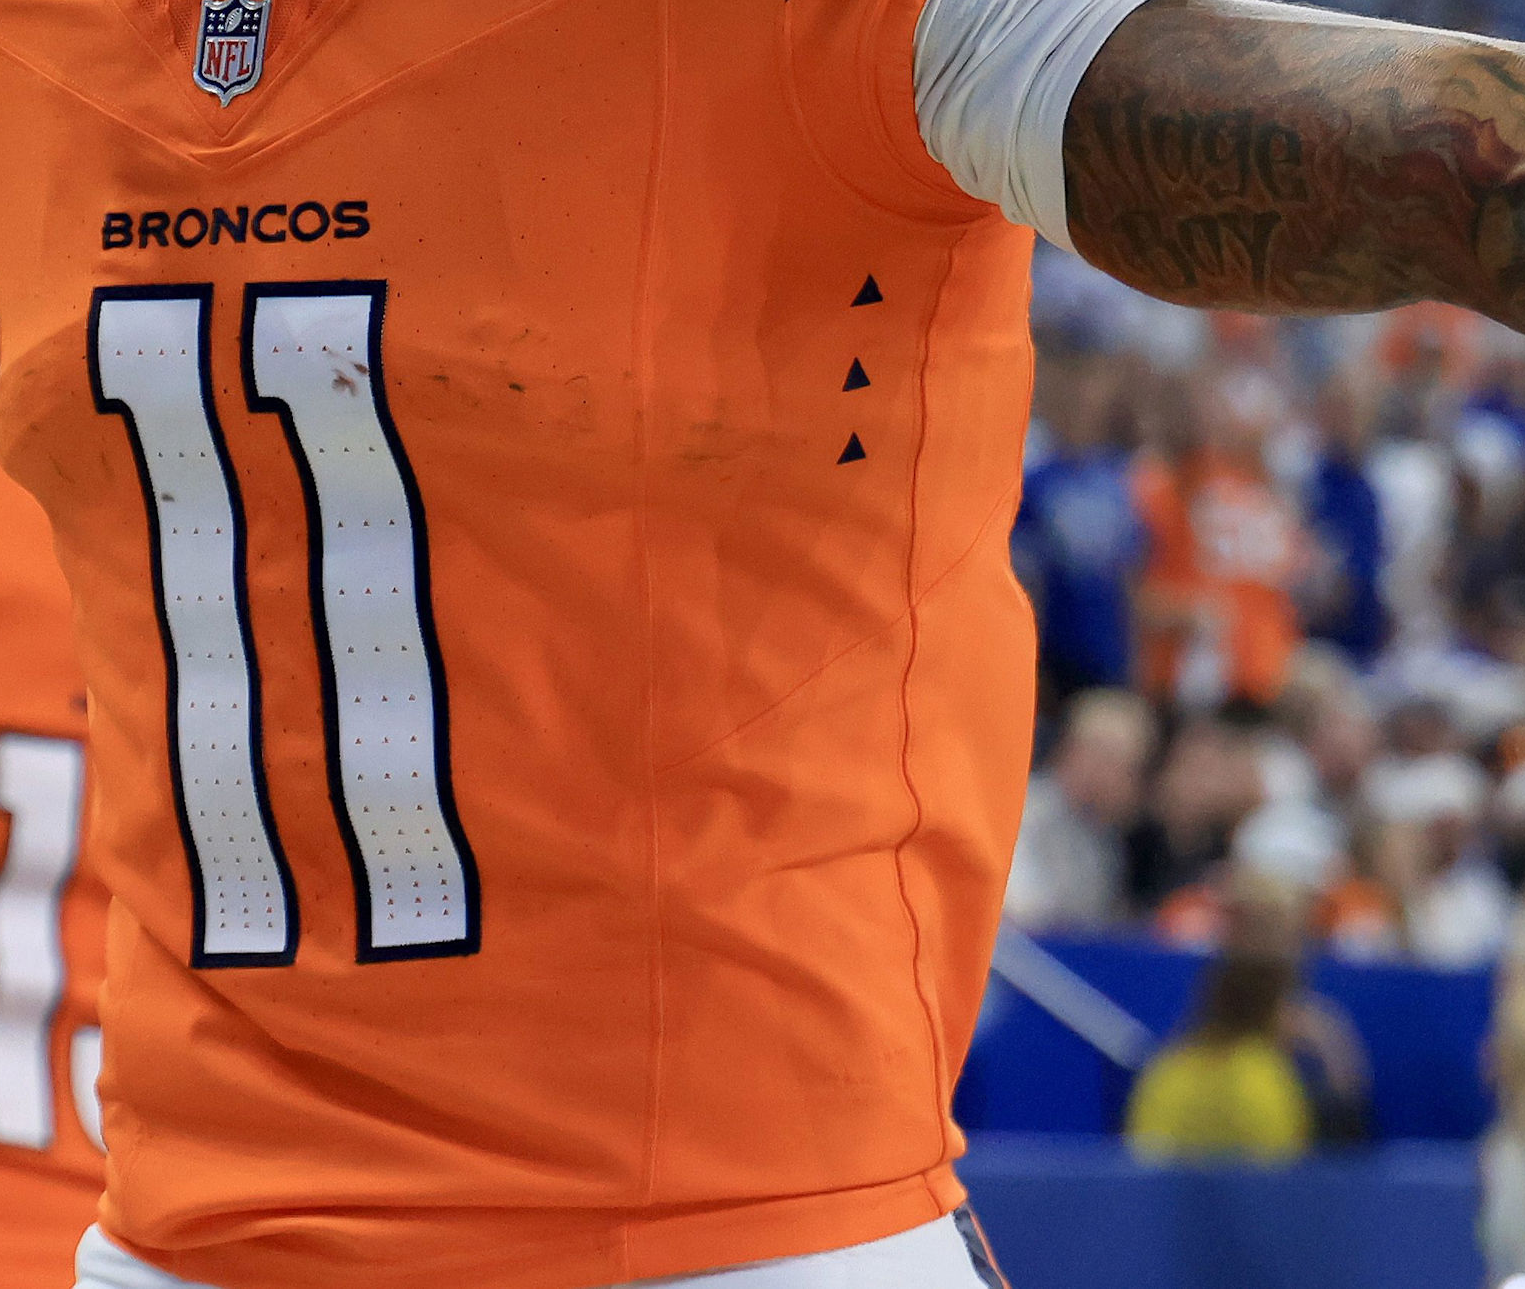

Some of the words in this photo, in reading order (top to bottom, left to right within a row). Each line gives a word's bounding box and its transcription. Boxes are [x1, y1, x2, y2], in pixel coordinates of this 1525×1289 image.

[204, 40, 250, 82] NFL
[101, 200, 370, 250] BRONCOS
[89, 280, 482, 968] 11
